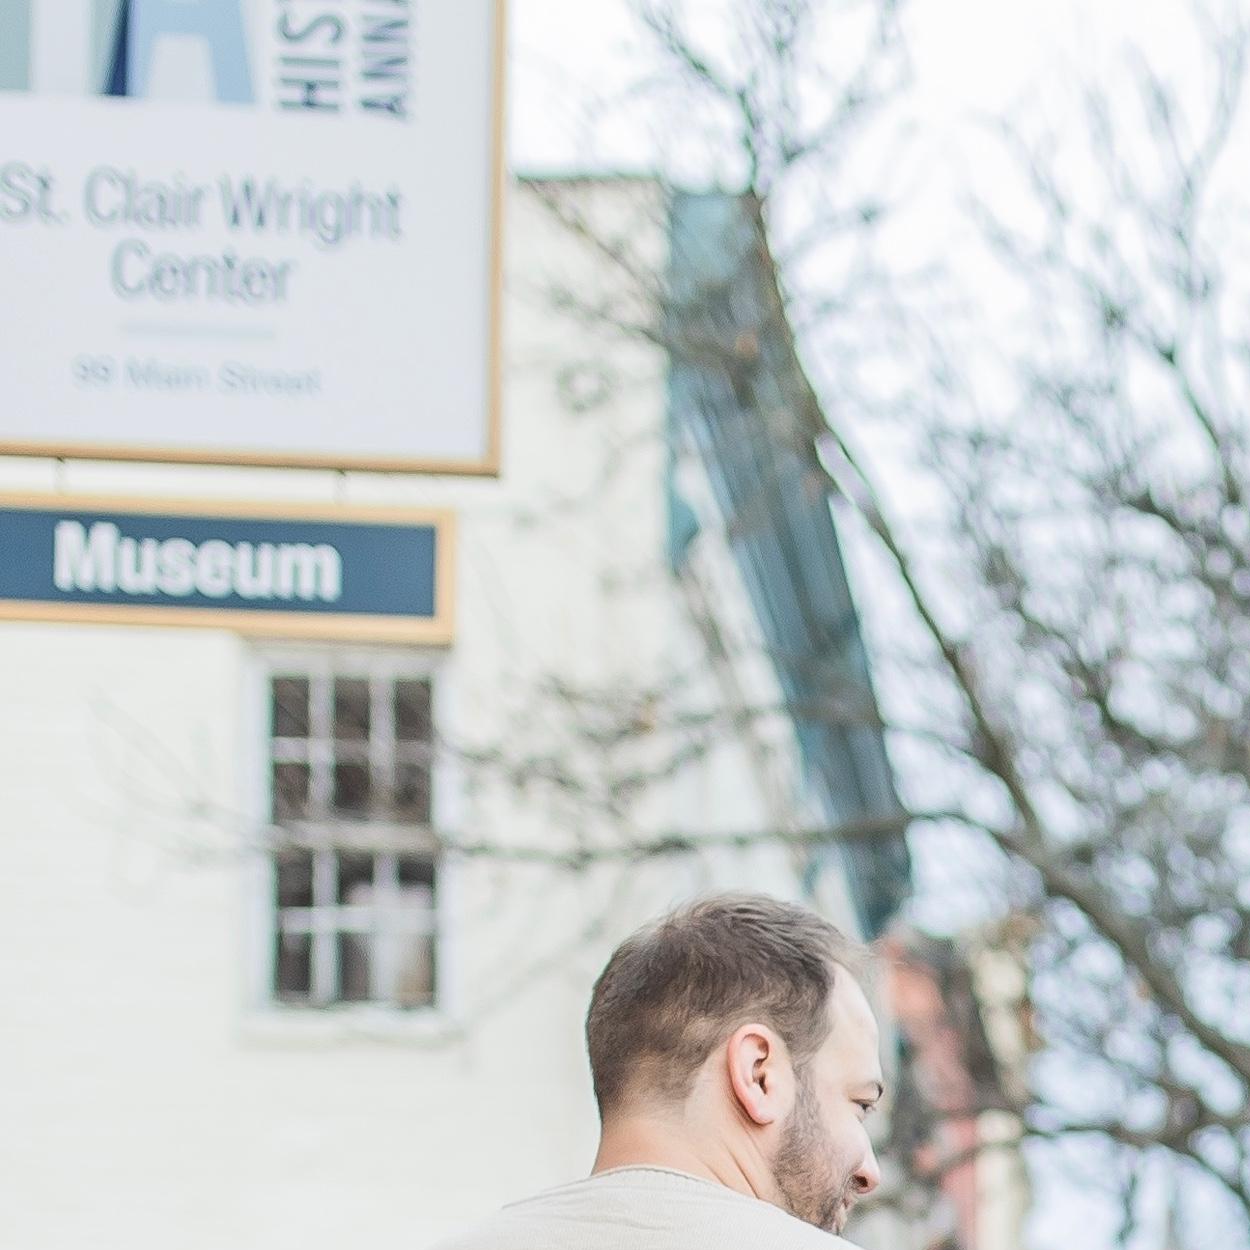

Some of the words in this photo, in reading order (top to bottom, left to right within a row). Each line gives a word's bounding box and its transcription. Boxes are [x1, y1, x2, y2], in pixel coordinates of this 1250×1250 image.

[359, 0, 410, 120] ANN
[83, 165, 205, 229] Clair
[217, 174, 403, 247] Wright
[110, 238, 292, 302] Center
[124, 354, 211, 392] Main
[217, 360, 322, 400] Street
[53, 519, 344, 602] Museum
